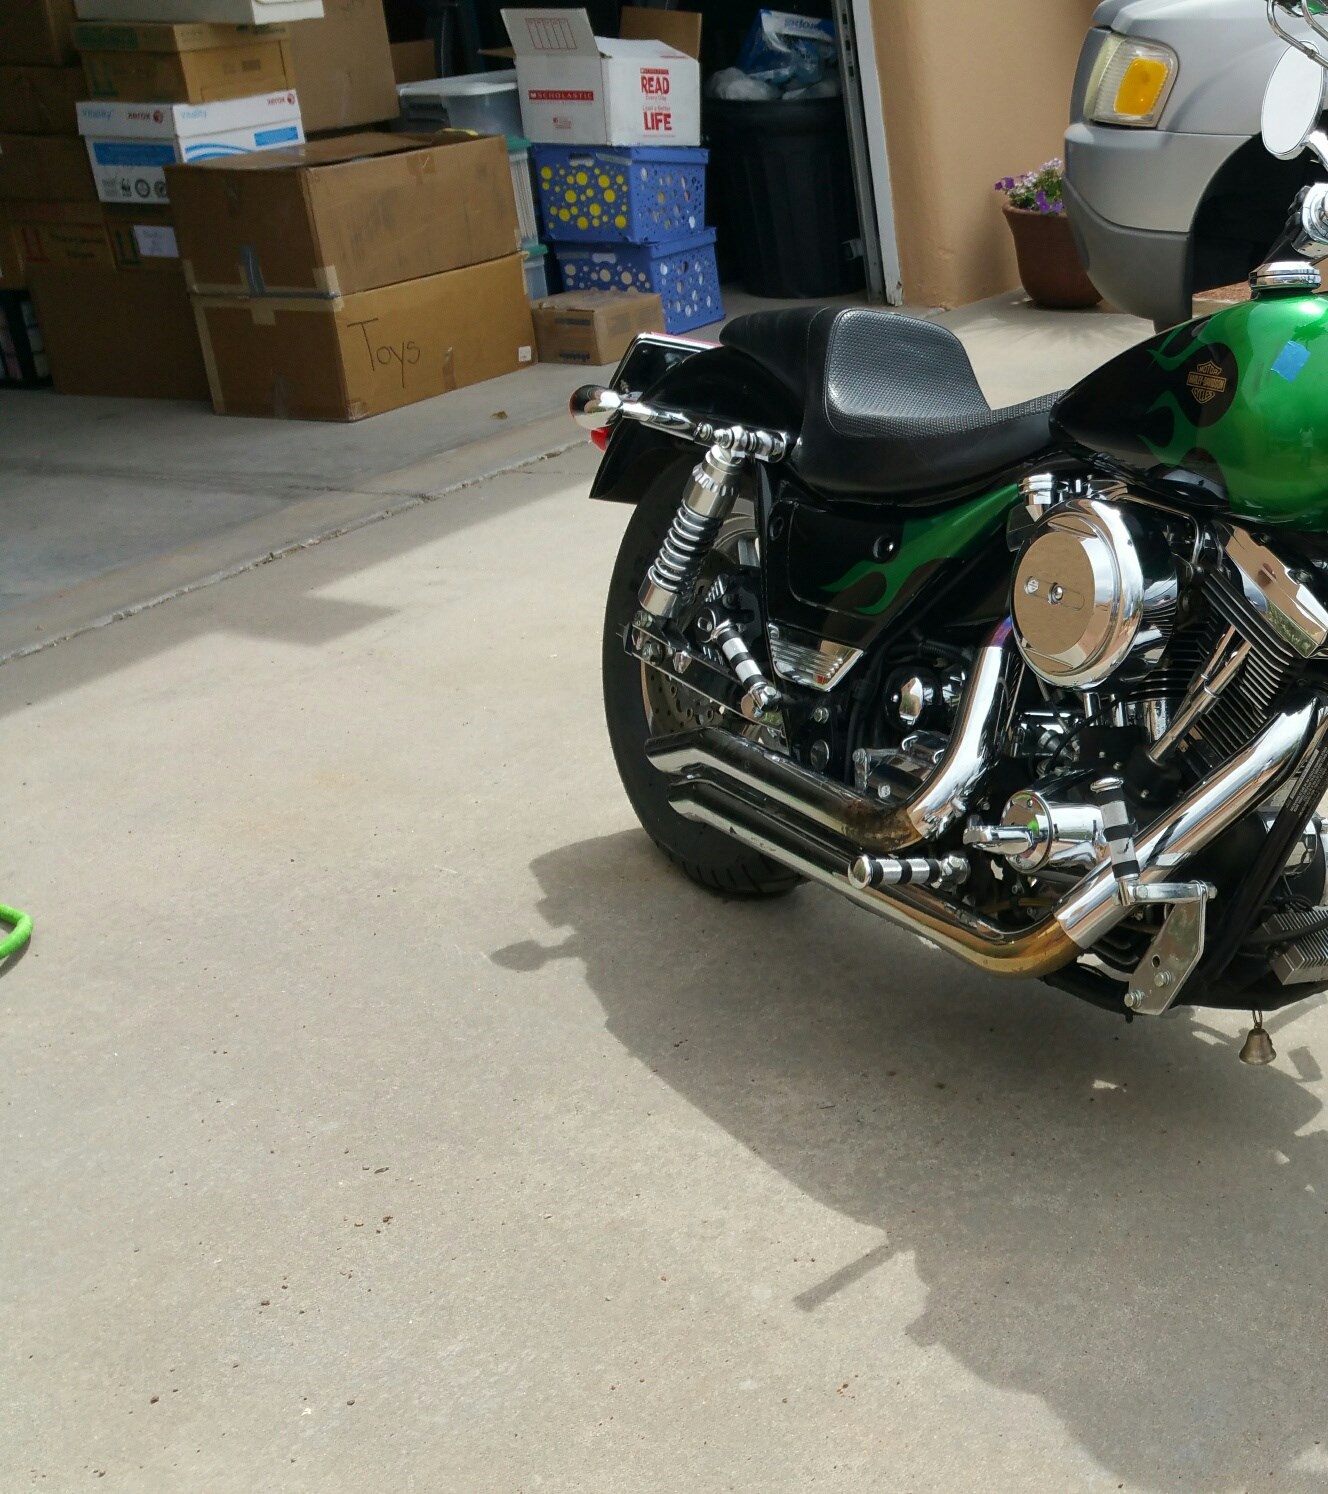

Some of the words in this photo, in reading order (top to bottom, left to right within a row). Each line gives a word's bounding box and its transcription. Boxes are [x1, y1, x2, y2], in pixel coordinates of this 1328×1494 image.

[537, 91, 593, 99] SCHOLASTIC
[641, 76, 670, 95] READ
[643, 112, 672, 131] LIFE
[347, 318, 420, 389] Toys
